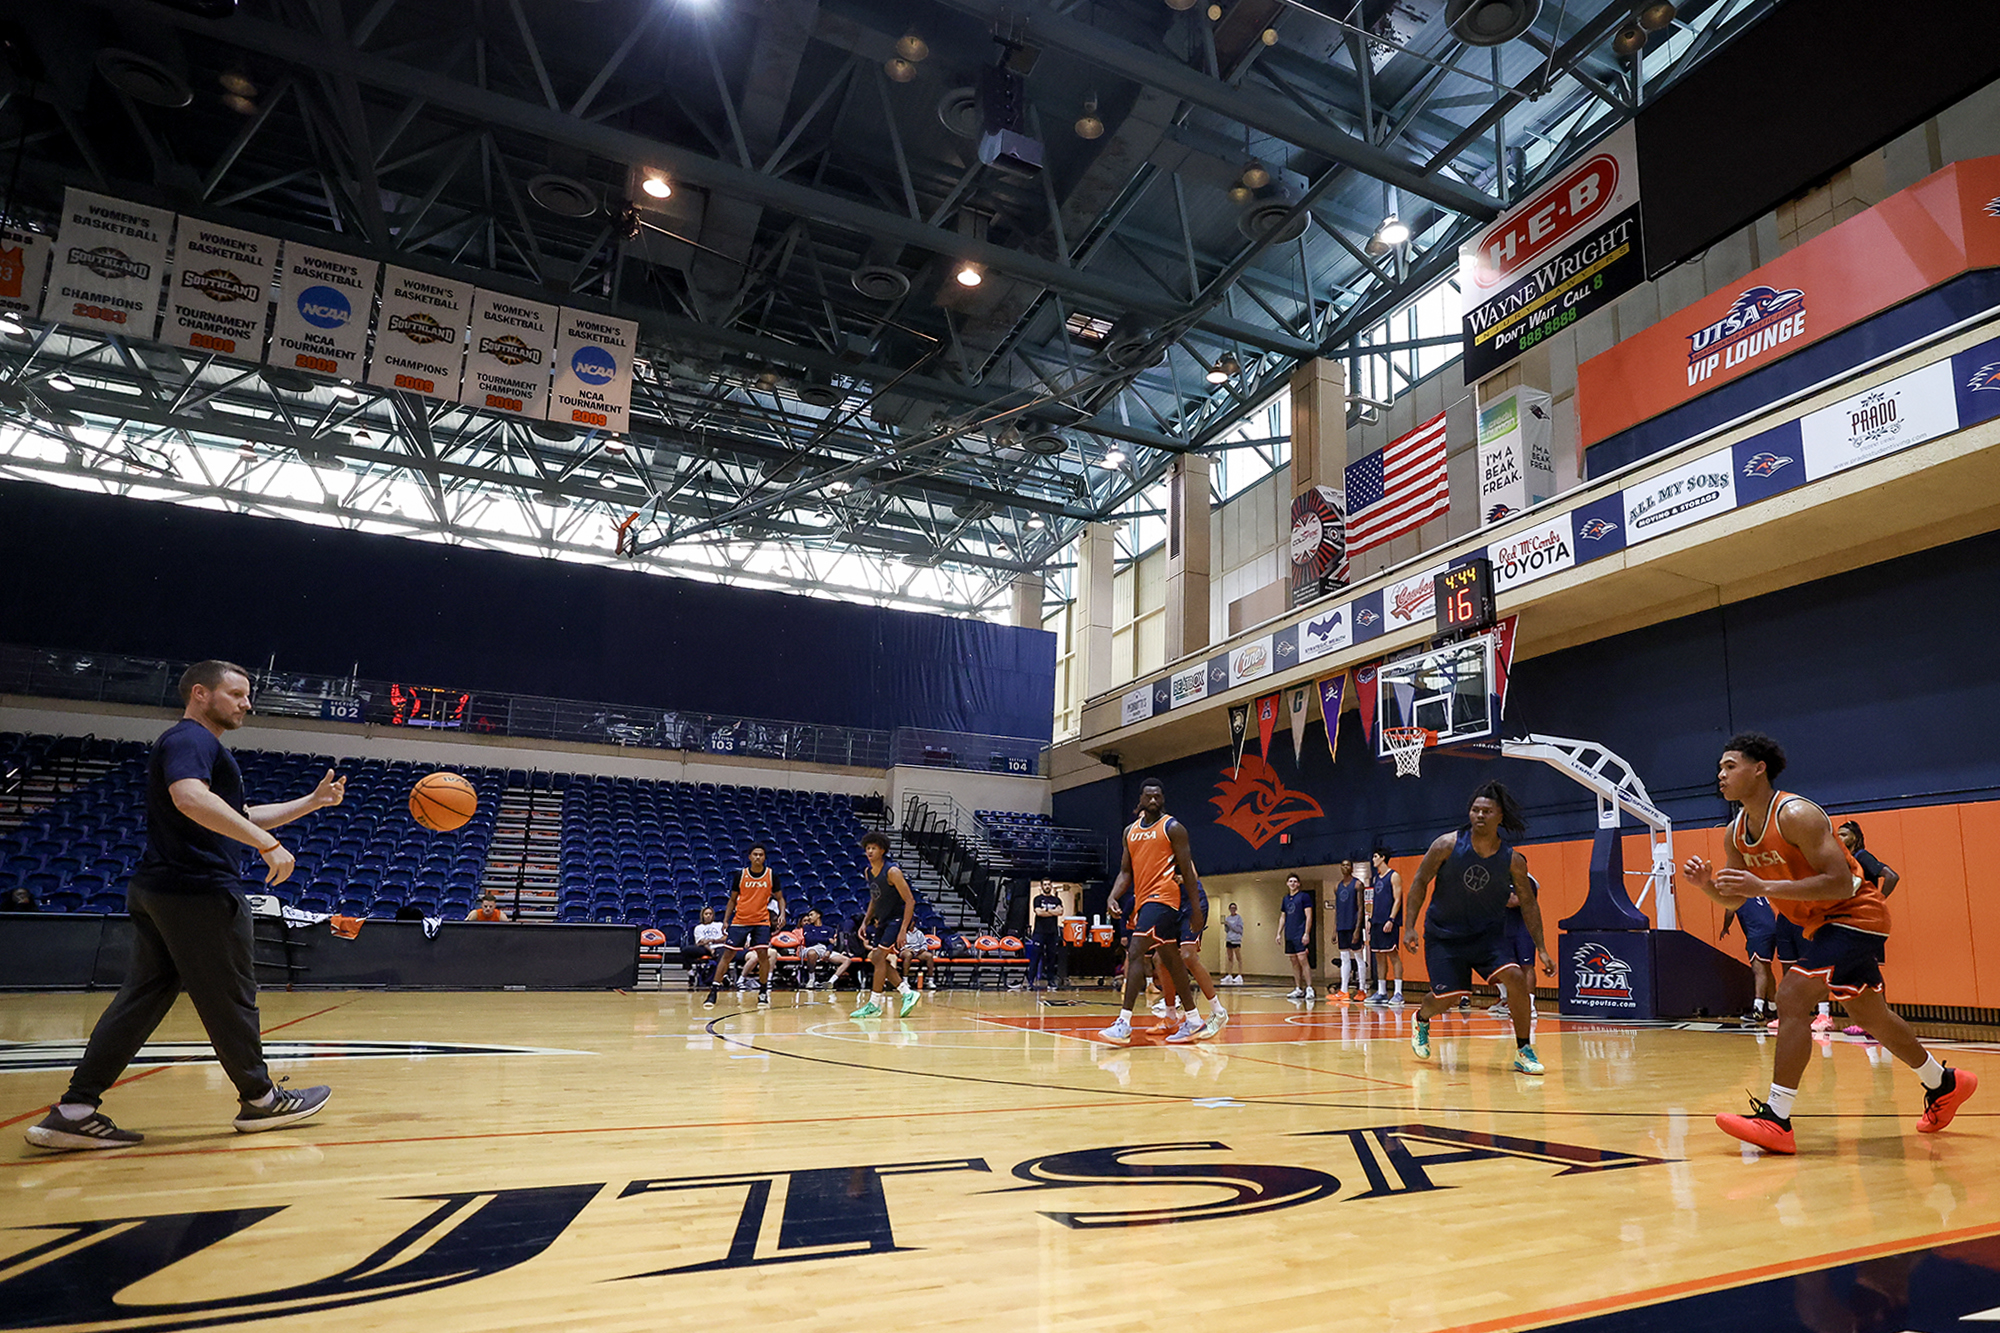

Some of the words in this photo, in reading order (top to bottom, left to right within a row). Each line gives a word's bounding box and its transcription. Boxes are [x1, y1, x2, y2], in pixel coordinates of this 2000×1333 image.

[89, 205, 150, 228] WOMEN'S
[73, 214, 158, 242] BASKETBALL
[199, 231, 258, 254] WOMEN'S
[188, 241, 264, 267] BASKETBALL
[303, 256, 358, 276] WOMEN'S
[183, 270, 259, 302] SOUTHLAND
[293, 265, 364, 289] BASKETBALL
[1593, 274, 1603, 290] 8
[61, 287, 143, 311] CHAMPIONS
[403, 279, 454, 298] WOMEN'S
[394, 288, 460, 311] BASKETBALL
[175, 305, 258, 330] TOURNAMENT
[302, 303, 349, 321] NCAA
[492, 302, 540, 320] WOMEN'S
[178, 318, 251, 340] CHAMPIONS
[388, 315, 455, 344] SOUTHLAND
[484, 311, 545, 333] BASKETBALL
[576, 319, 621, 336] WOMEN'S
[1692, 304, 1761, 351] UTSA
[304, 333, 335, 346] NCAA
[568, 328, 626, 347] BASKETBALL
[280, 337, 356, 360] TOURNAMENT
[479, 336, 542, 364] SOUTHLAND
[1687, 353, 1720, 387] VIP
[1725, 310, 1807, 369] LOUNGE
[295, 353, 337, 373] 2008
[385, 355, 449, 376] CHAMPIONS
[576, 362, 615, 379] NCAA
[476, 372, 537, 391] TOURNAMENT
[479, 382, 533, 399] CHAMPIONS
[558, 395, 622, 414] TOURNAMENT
[579, 390, 604, 402] NCAA
[572, 409, 607, 426] 2009
[1851, 398, 1897, 436] PRADO
[1505, 446, 1513, 456] A
[1485, 457, 1515, 481] BEAK
[1483, 470, 1522, 496] FREAK.
[1629, 495, 1656, 526] ALL
[1658, 480, 1685, 503] MY
[1687, 472, 1730, 492] SONS
[1638, 510, 1670, 527] MOVING
[1680, 492, 1717, 511] STORAGE
[1493, 541, 1570, 583] TOYOTA
[1499, 545, 1517, 565] Red
[1445, 567, 1476, 589] 4:44
[1447, 587, 1473, 623] 16
[330, 706, 358, 718] 102
[711, 740, 733, 751] 103
[1009, 762, 1027, 771] 104
[1570, 761, 1598, 780] LEGACY
[1632, 799, 1659, 819] SPORTS
[1130, 830, 1157, 842] UTSA
[1581, 973, 1627, 990] UTSA
[1570, 998, 1637, 1008] www.goutsa.com
[0, 1123, 1690, 1333] UTSA
